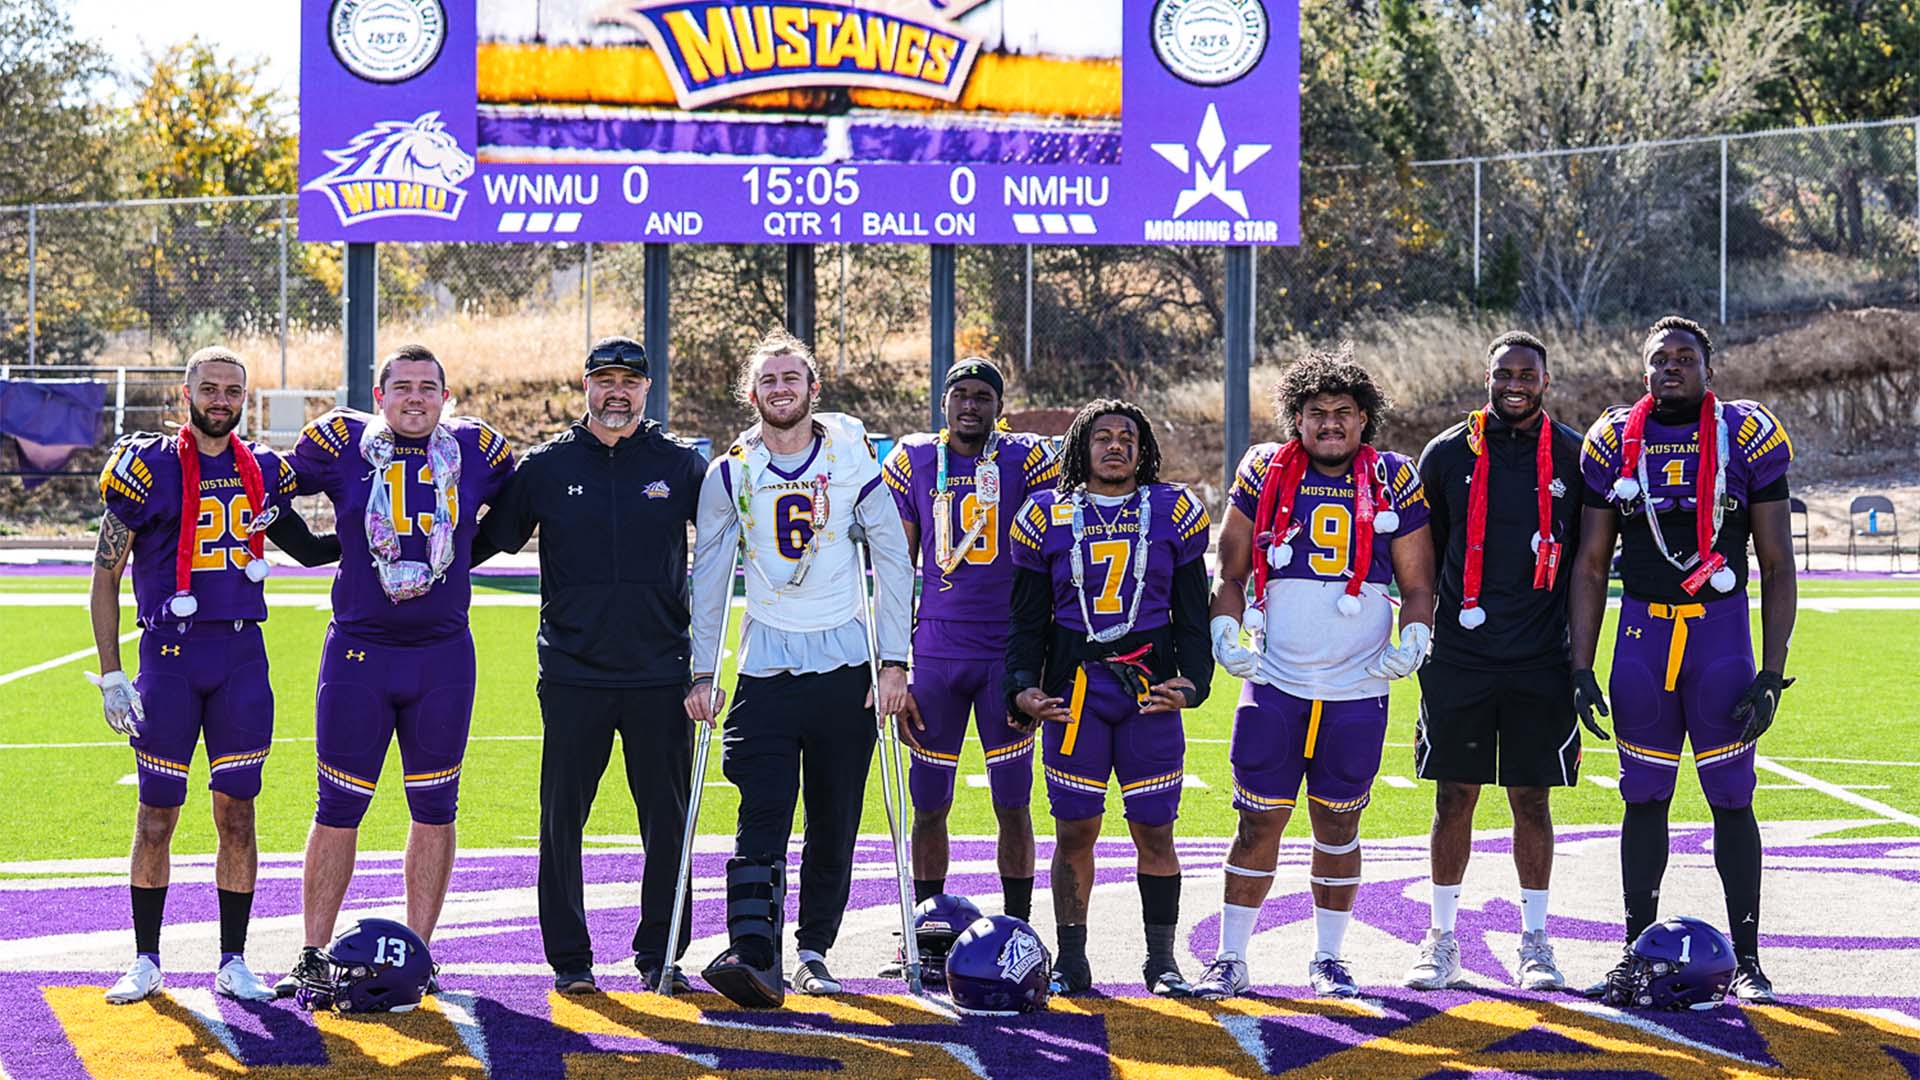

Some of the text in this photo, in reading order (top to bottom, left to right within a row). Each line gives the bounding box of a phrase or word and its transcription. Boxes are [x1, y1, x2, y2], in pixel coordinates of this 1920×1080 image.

[420, 5, 437, 35] CITY
[1243, 10, 1259, 38] CITY
[662, 5, 957, 84] MUSTANGS
[1190, 34, 1230, 47] 1878
[338, 182, 447, 214] WNMU
[483, 165, 649, 205] WNMU 0
[742, 166, 860, 205] 15:05
[950, 166, 1109, 206] 0 NMHU
[644, 211, 703, 235] AND
[764, 212, 841, 236] QTR 1
[862, 212, 975, 235] BALL ON
[1144, 219, 1278, 241] MORNING STAR
[395, 446, 427, 456] USTA
[1645, 443, 1700, 455] MUSTAN
[199, 478, 244, 491] USTAN
[946, 475, 977, 487] USTA
[1660, 459, 1690, 486] 1
[1300, 485, 1354, 498] MUSTANG
[774, 493, 815, 562] 6
[1308, 503, 1351, 576] 9
[1089, 539, 1131, 614] 7
[374, 936, 406, 967] 13
[1679, 935, 1691, 963] 1
